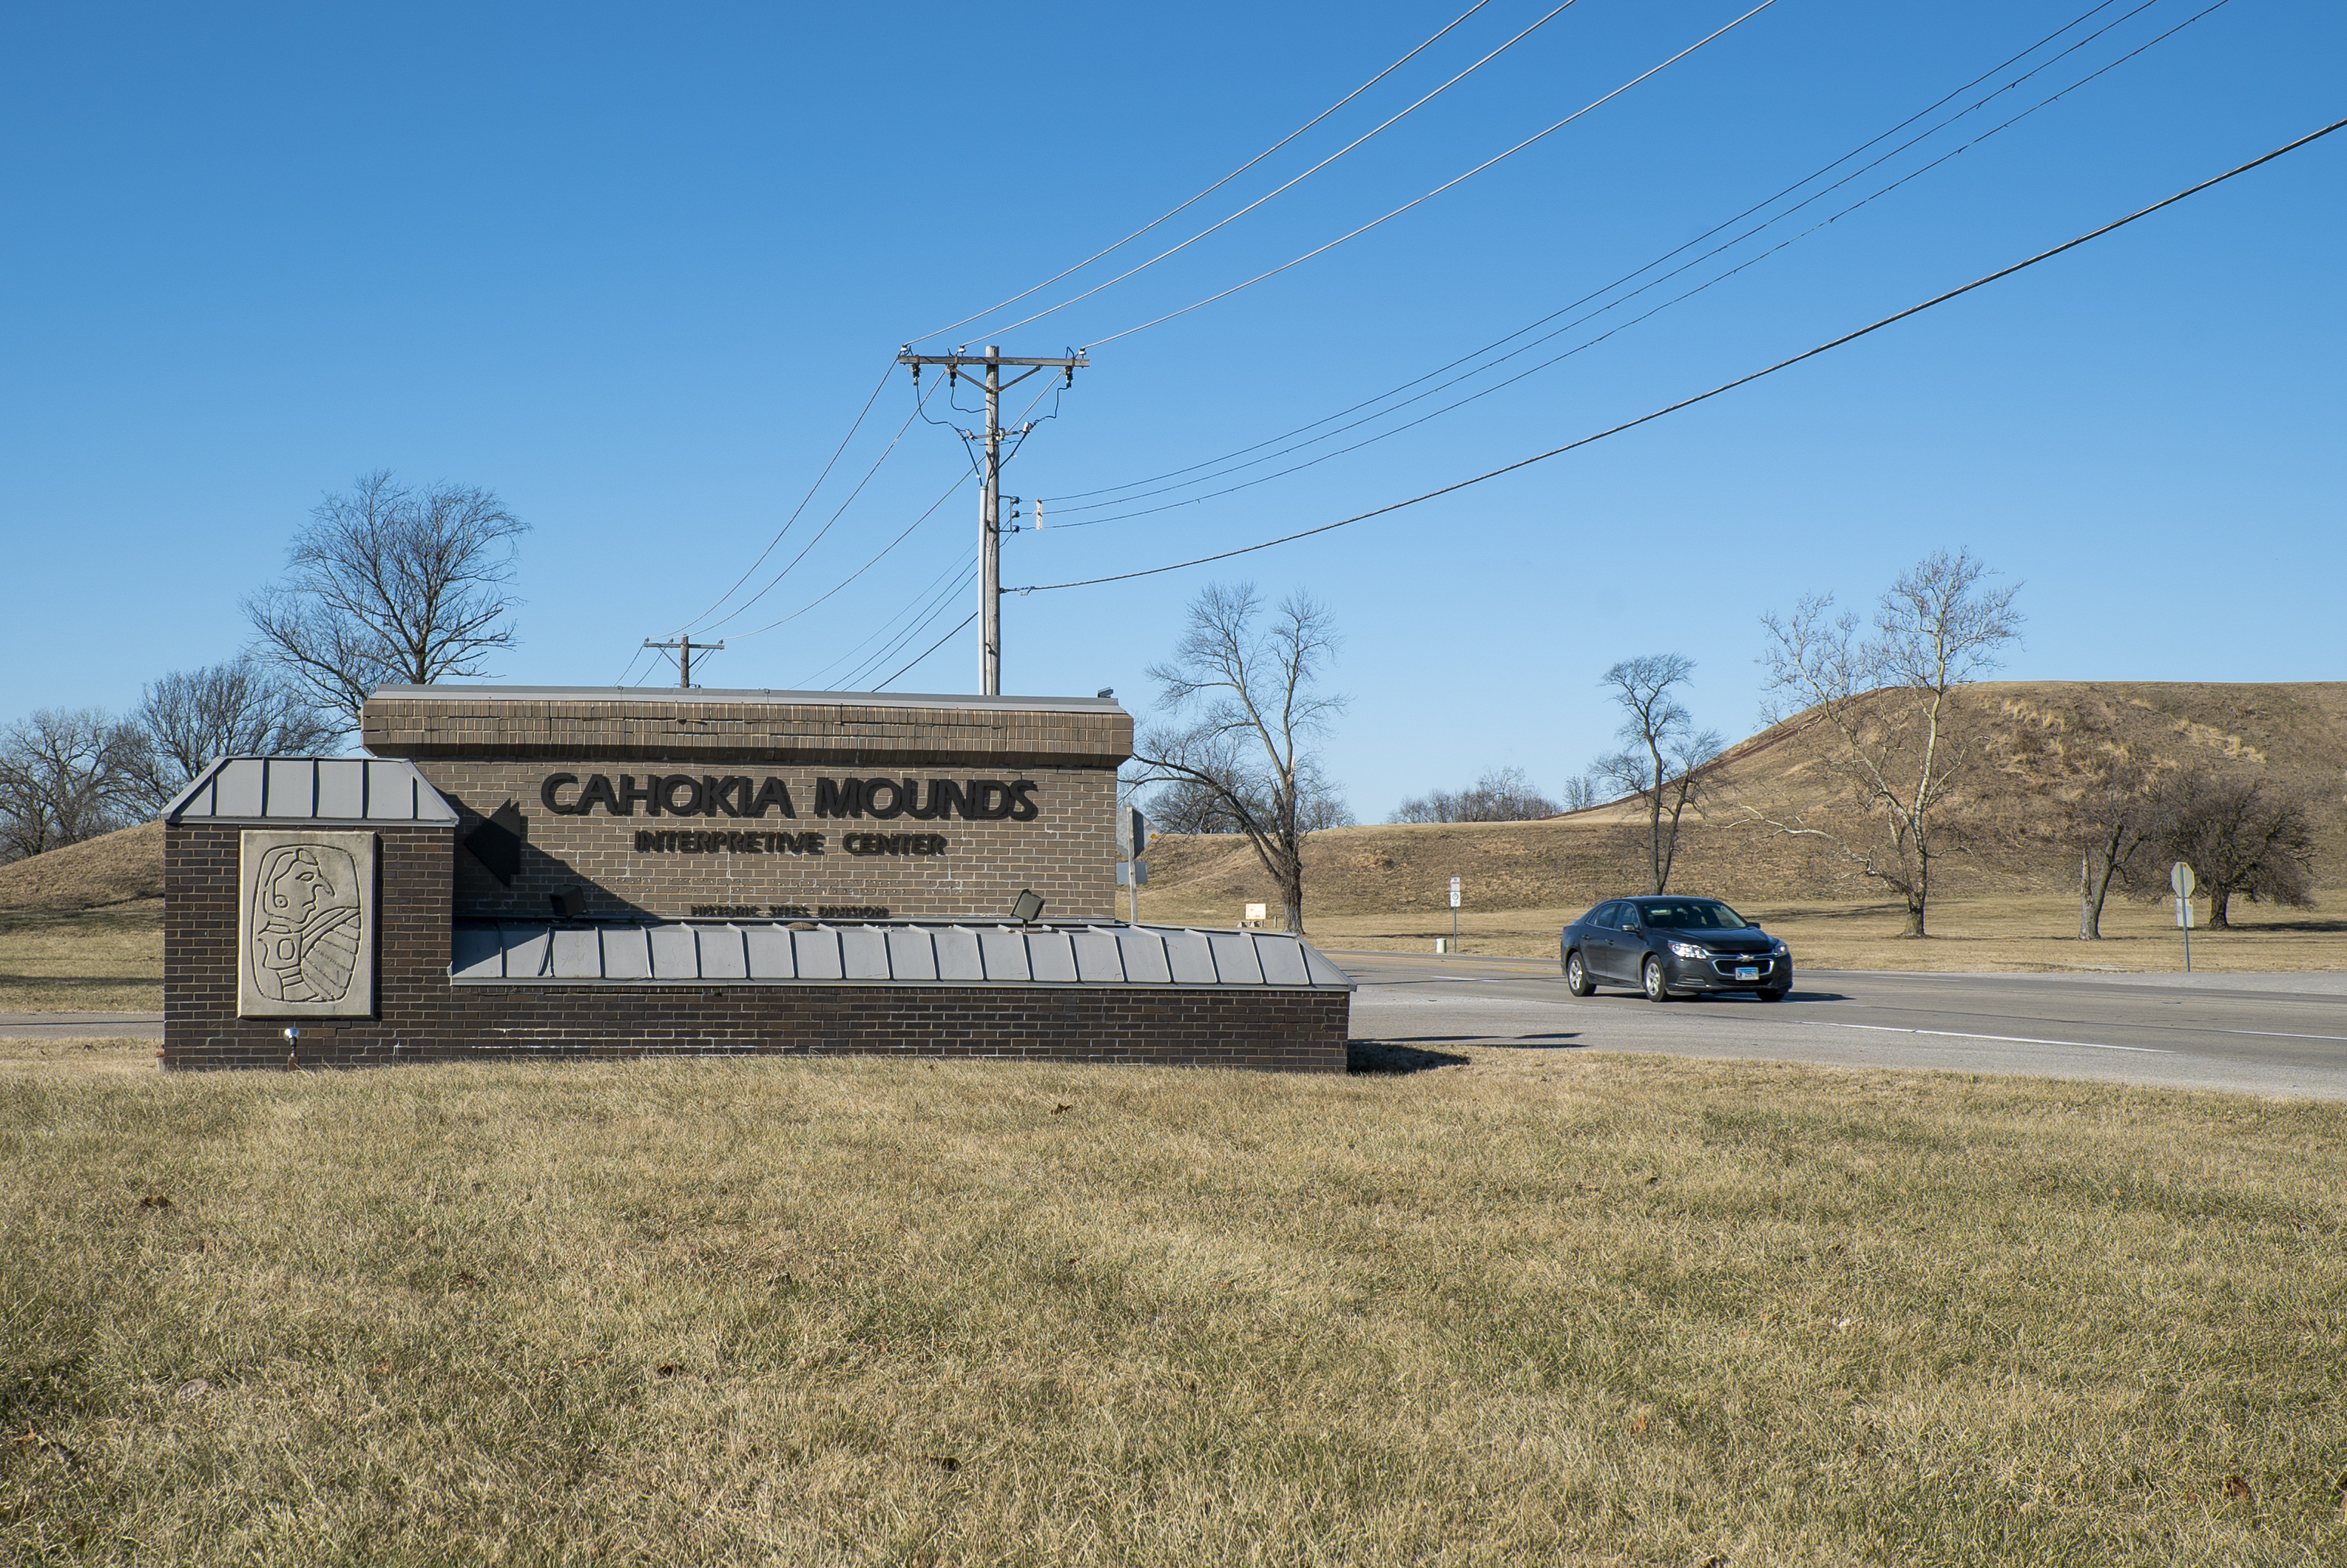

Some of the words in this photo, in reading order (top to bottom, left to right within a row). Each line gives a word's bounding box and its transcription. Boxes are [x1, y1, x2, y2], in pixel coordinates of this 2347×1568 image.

[541, 773, 791, 817] CAHOKIA
[814, 777, 1037, 820] MOUNDS
[634, 830, 823, 853] INTERPRETIVE
[842, 832, 946, 855] CENTER
[690, 905, 759, 917] HISTORIC
[769, 905, 810, 917] SITES
[817, 905, 888, 918] DIVISION
